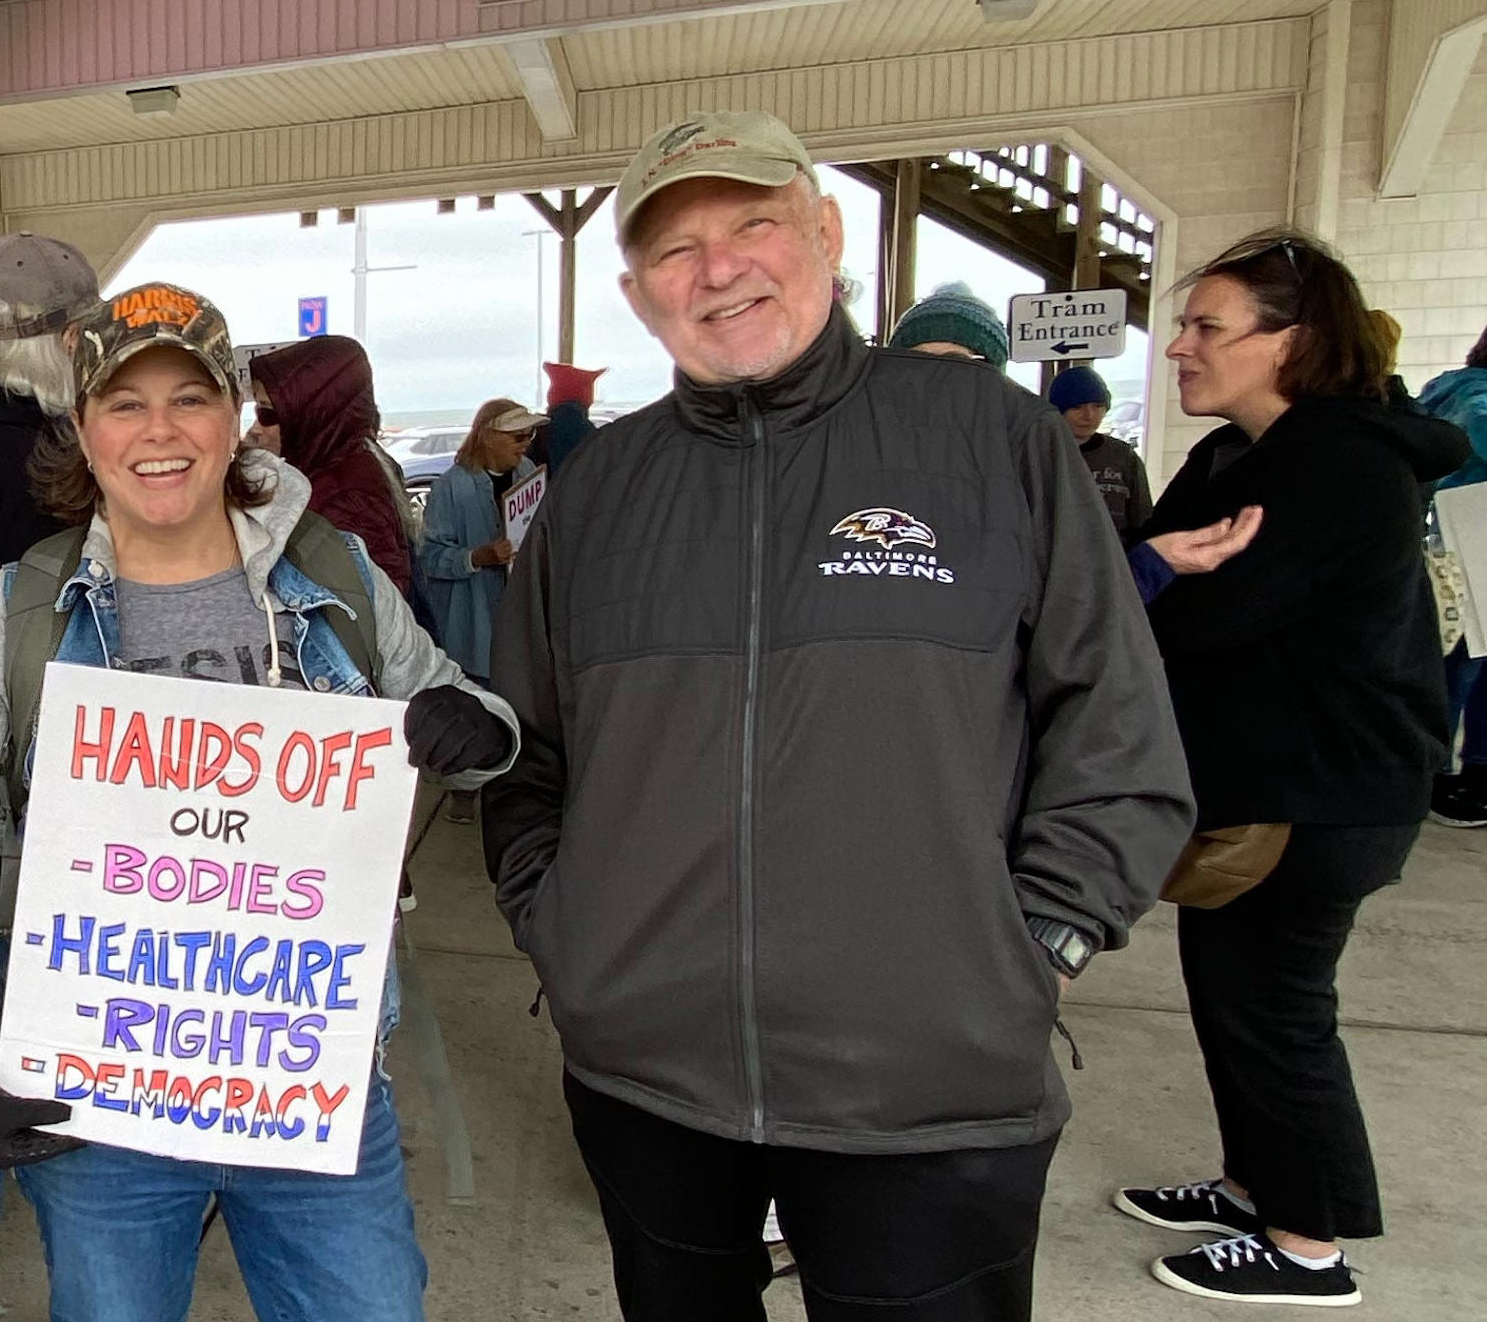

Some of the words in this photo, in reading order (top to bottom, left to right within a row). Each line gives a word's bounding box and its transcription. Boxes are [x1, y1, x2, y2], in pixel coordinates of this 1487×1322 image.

[1031, 299, 1106, 319] Tram
[1018, 321, 1120, 342] Entrance
[509, 480, 542, 522] DUMP
[843, 551, 937, 565] BALTIMORE
[818, 561, 955, 584] RAVENS
[70, 704, 264, 798] HANDS
[276, 727, 392, 812] OFF
[170, 807, 250, 844] OUR
